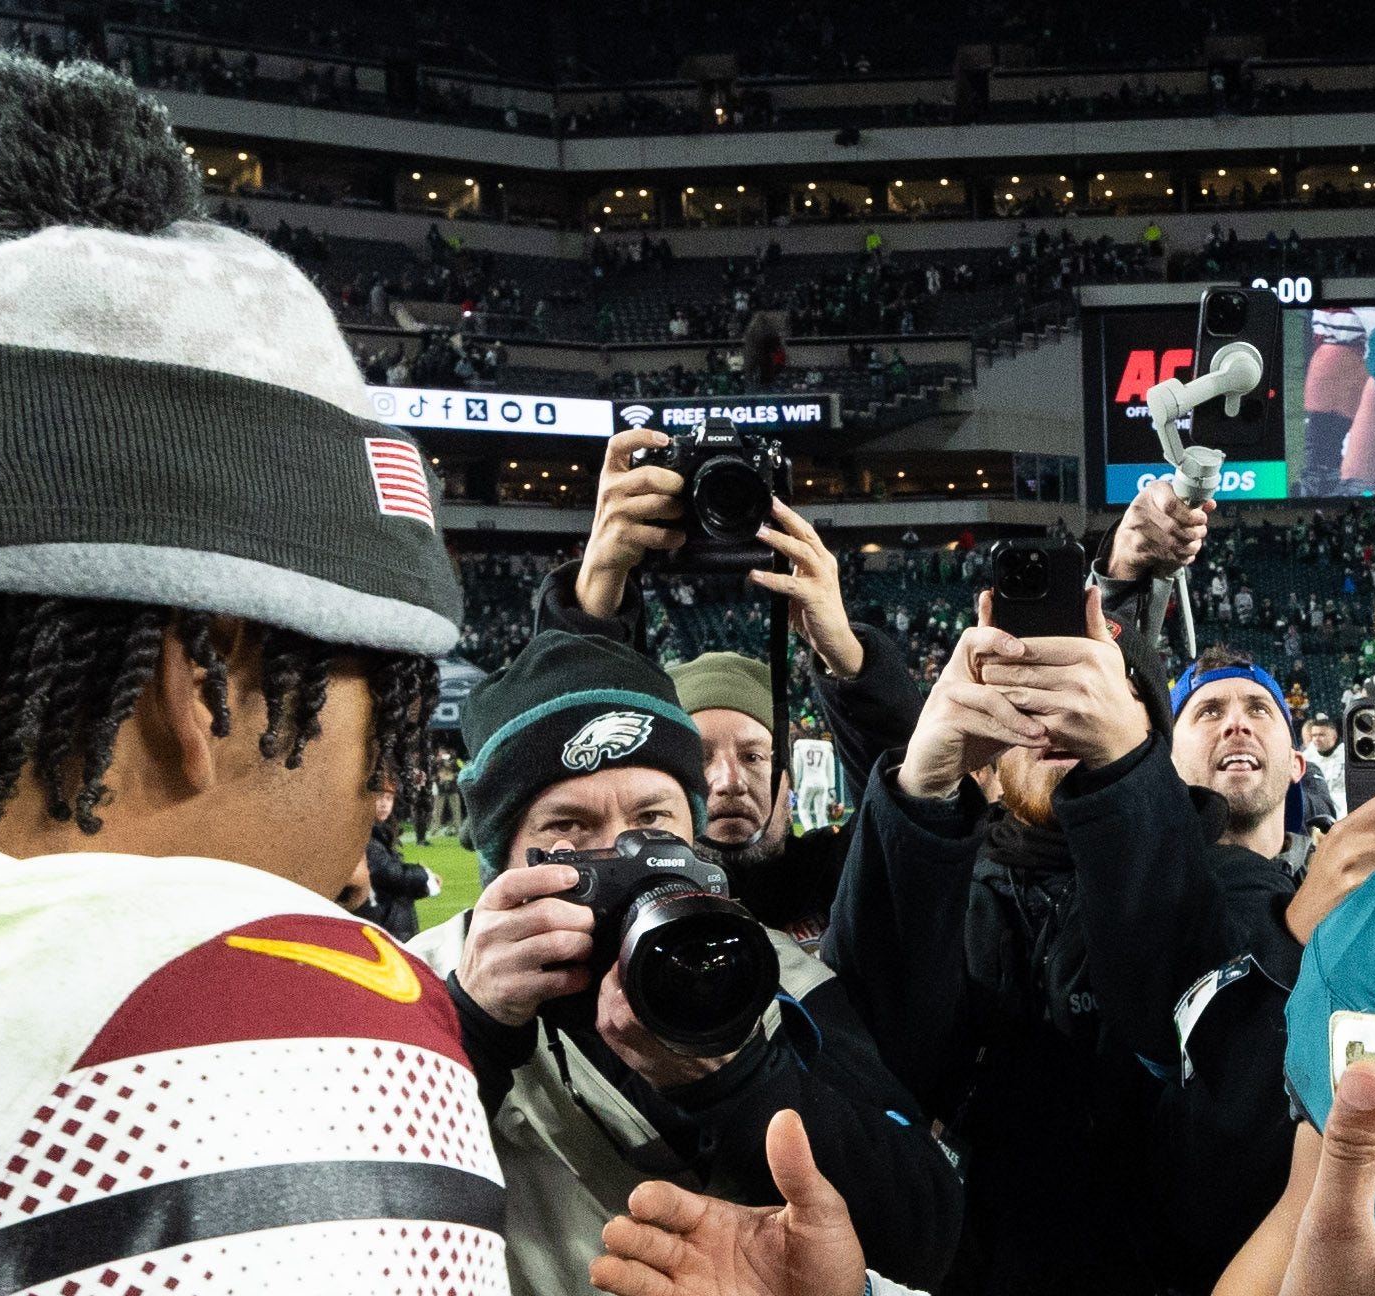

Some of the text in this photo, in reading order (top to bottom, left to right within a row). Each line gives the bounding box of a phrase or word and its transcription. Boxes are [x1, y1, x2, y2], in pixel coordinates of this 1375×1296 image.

[663, 408, 706, 426] FREE
[782, 404, 821, 422] WIFI
[806, 749, 824, 768] 97
[646, 857, 686, 867] Canon
[708, 874, 721, 882] EOS
